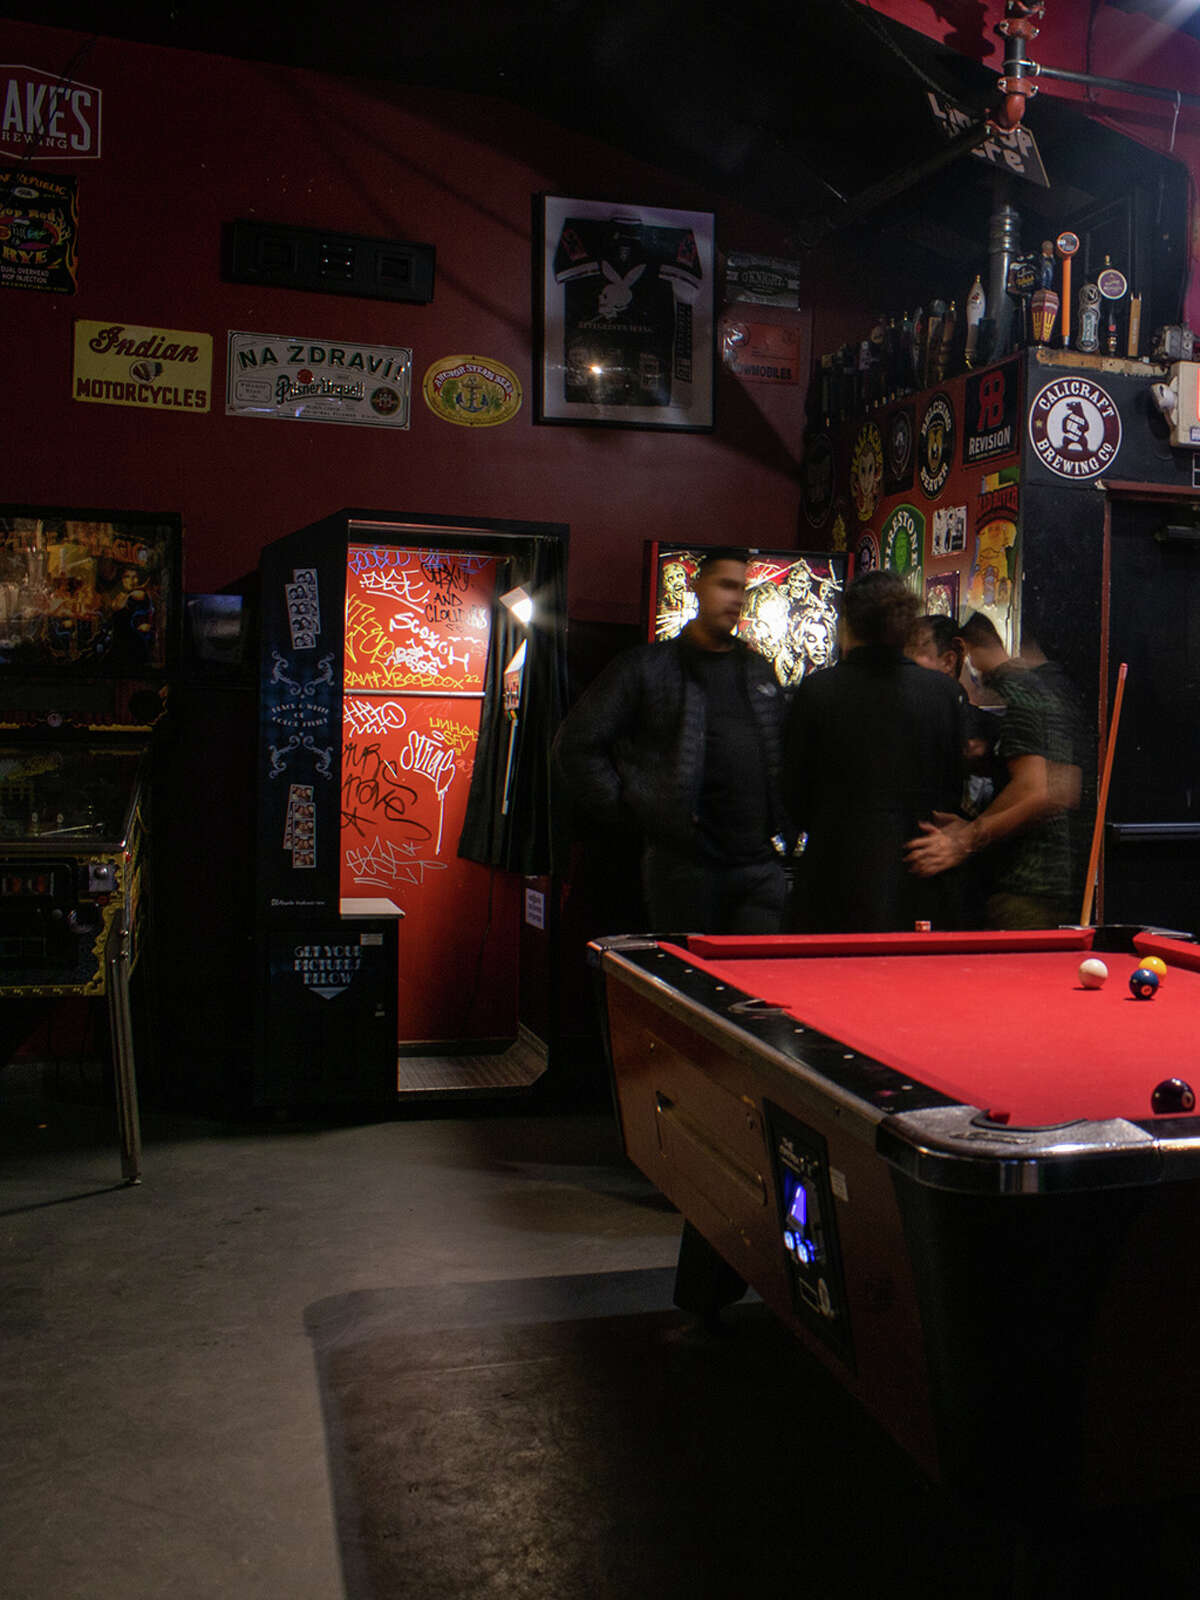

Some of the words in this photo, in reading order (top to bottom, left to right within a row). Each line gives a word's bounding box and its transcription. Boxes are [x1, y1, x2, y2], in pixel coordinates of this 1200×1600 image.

[2, 245, 48, 264] RYE
[89, 326, 199, 362] Indian
[239, 347, 278, 368] NA
[465, 364, 495, 381] STEAM
[77, 378, 206, 408] MOTORCYCLES
[1038, 380, 1115, 418] CALICRAFT
[968, 424, 1011, 457] REVISION
[1037, 438, 1100, 475] BREWING
[434, 593, 463, 608] AND
[294, 945, 321, 958] GET
[294, 959, 361, 972] PICTURES
[303, 971, 353, 985] BELOW
